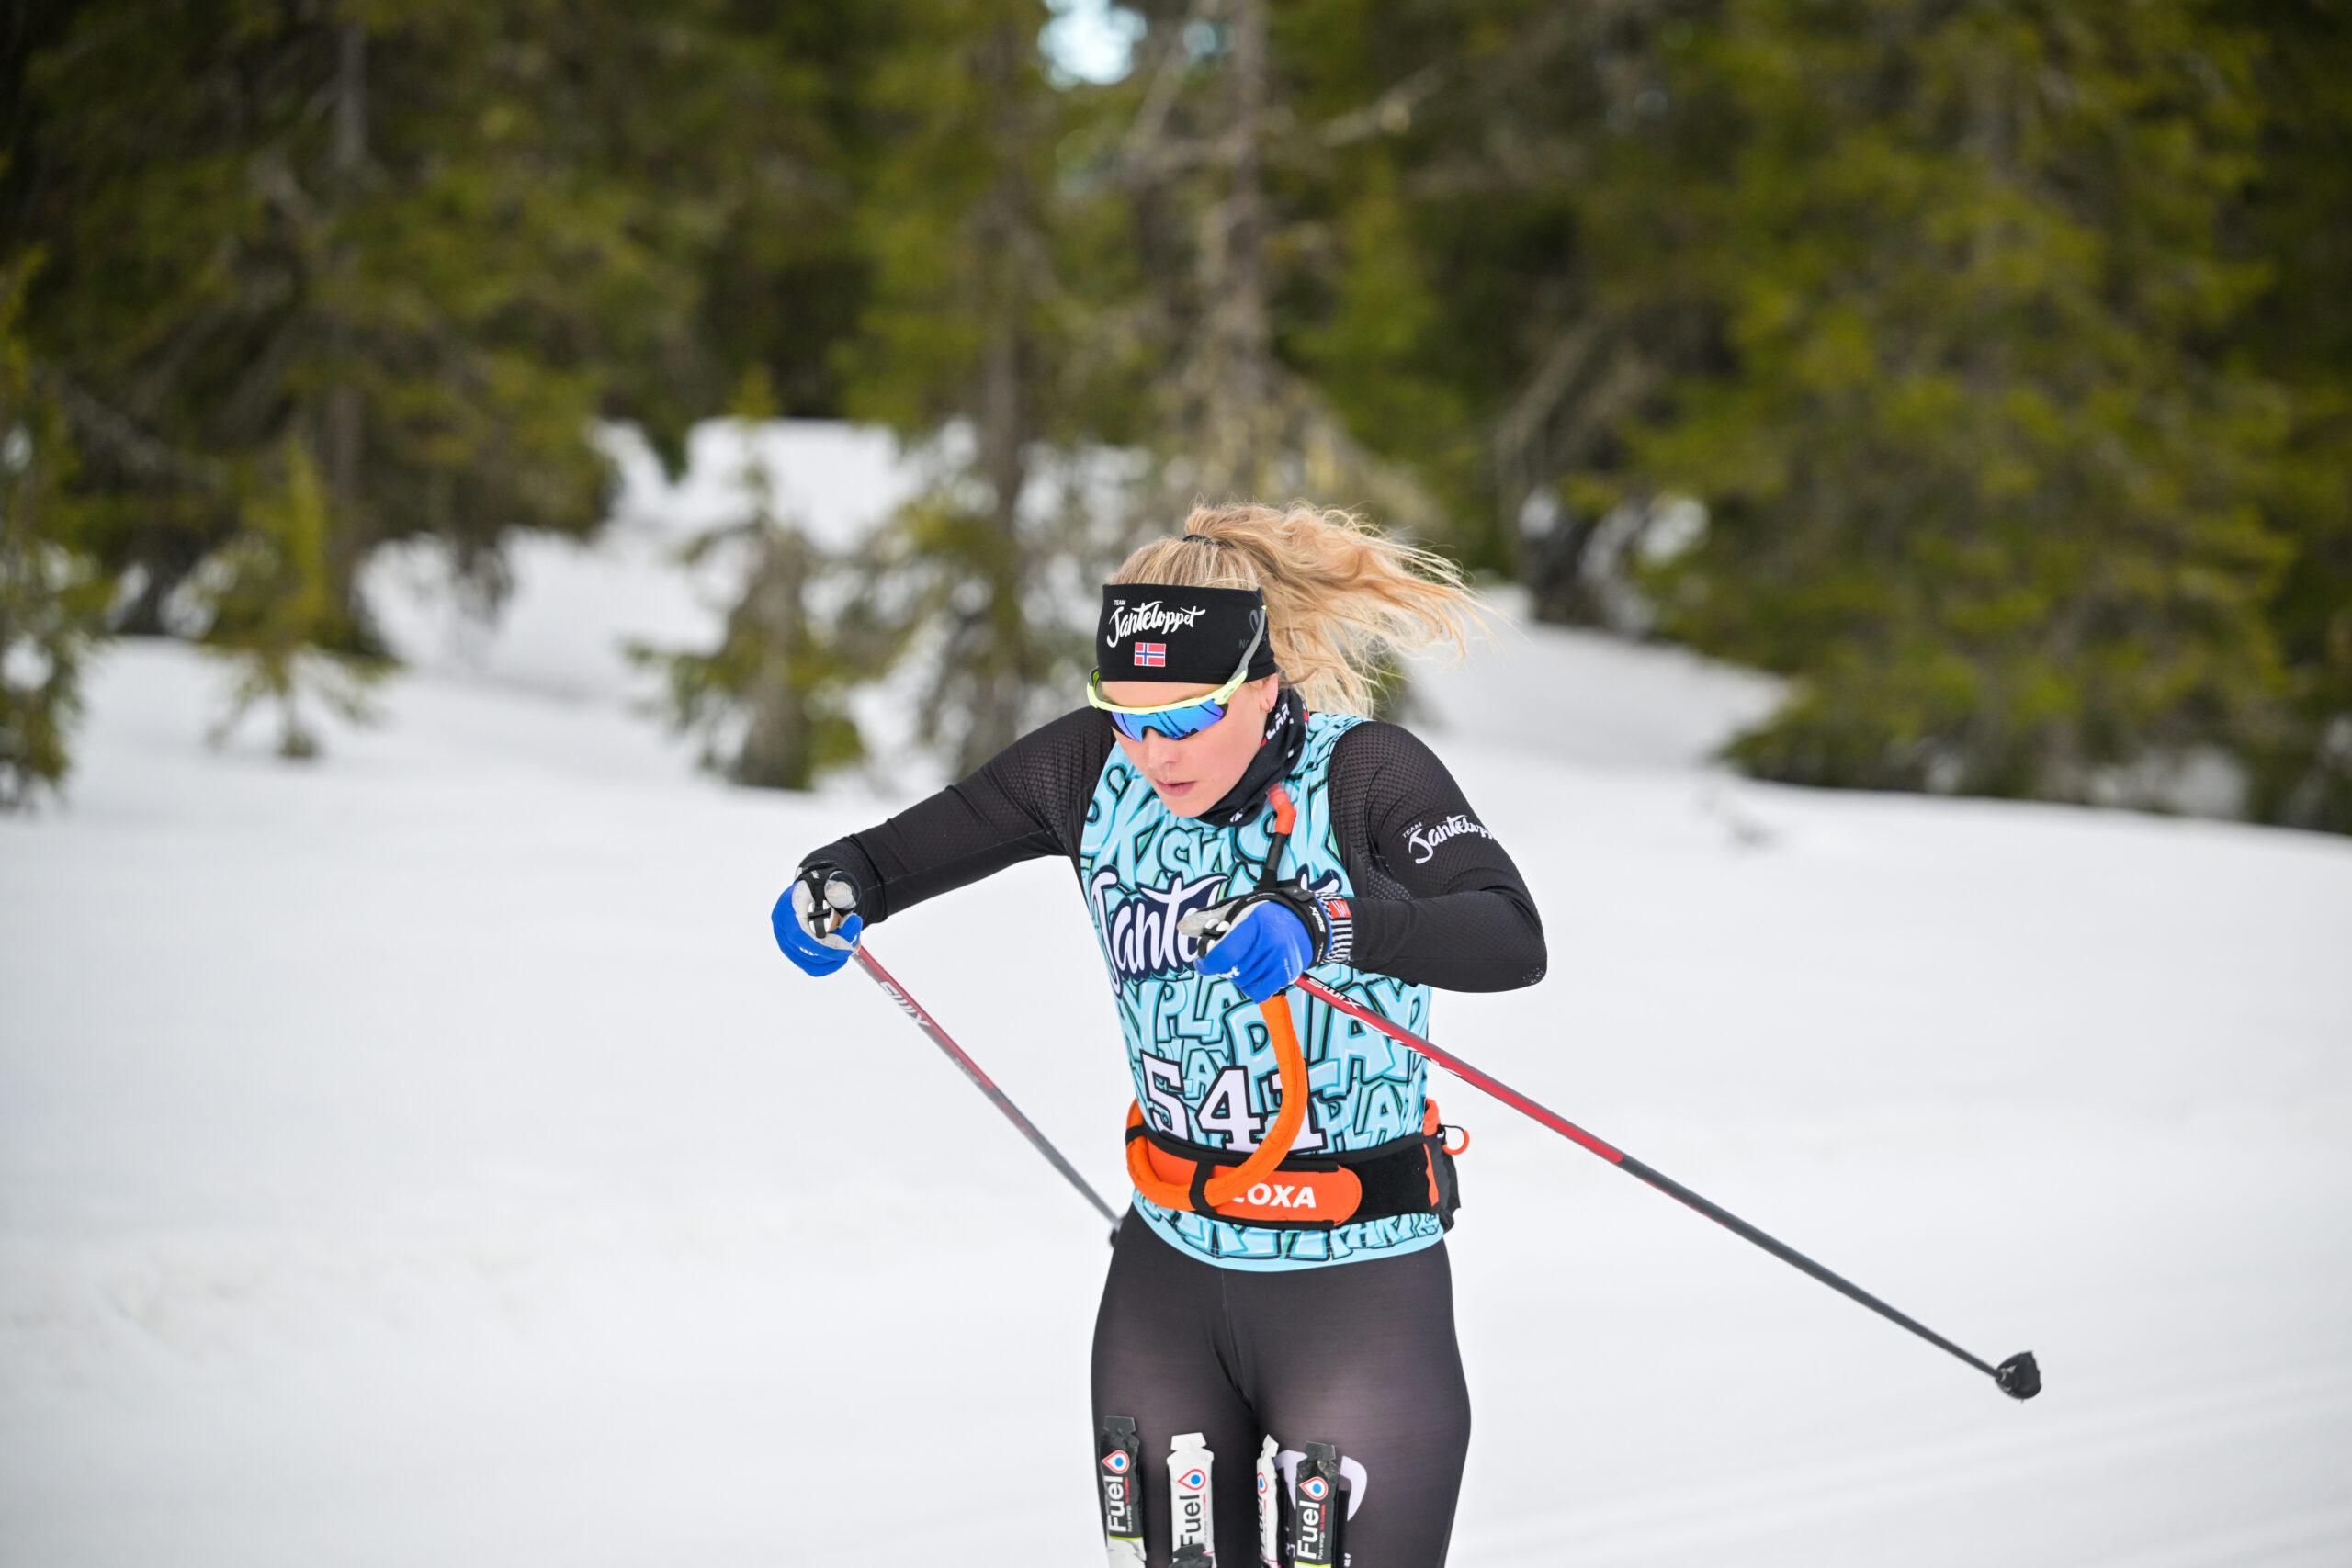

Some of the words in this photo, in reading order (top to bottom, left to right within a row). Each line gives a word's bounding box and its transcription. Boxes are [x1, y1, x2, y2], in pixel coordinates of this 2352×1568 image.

[1106, 601, 1205, 648] Janteloppet
[1402, 822, 1422, 838] TEAM
[1306, 977, 1362, 1010] SWIX
[1232, 1182, 1317, 1209] OXA
[1104, 1475, 1127, 1532] Fuel
[1296, 1500, 1320, 1560] Fuel
